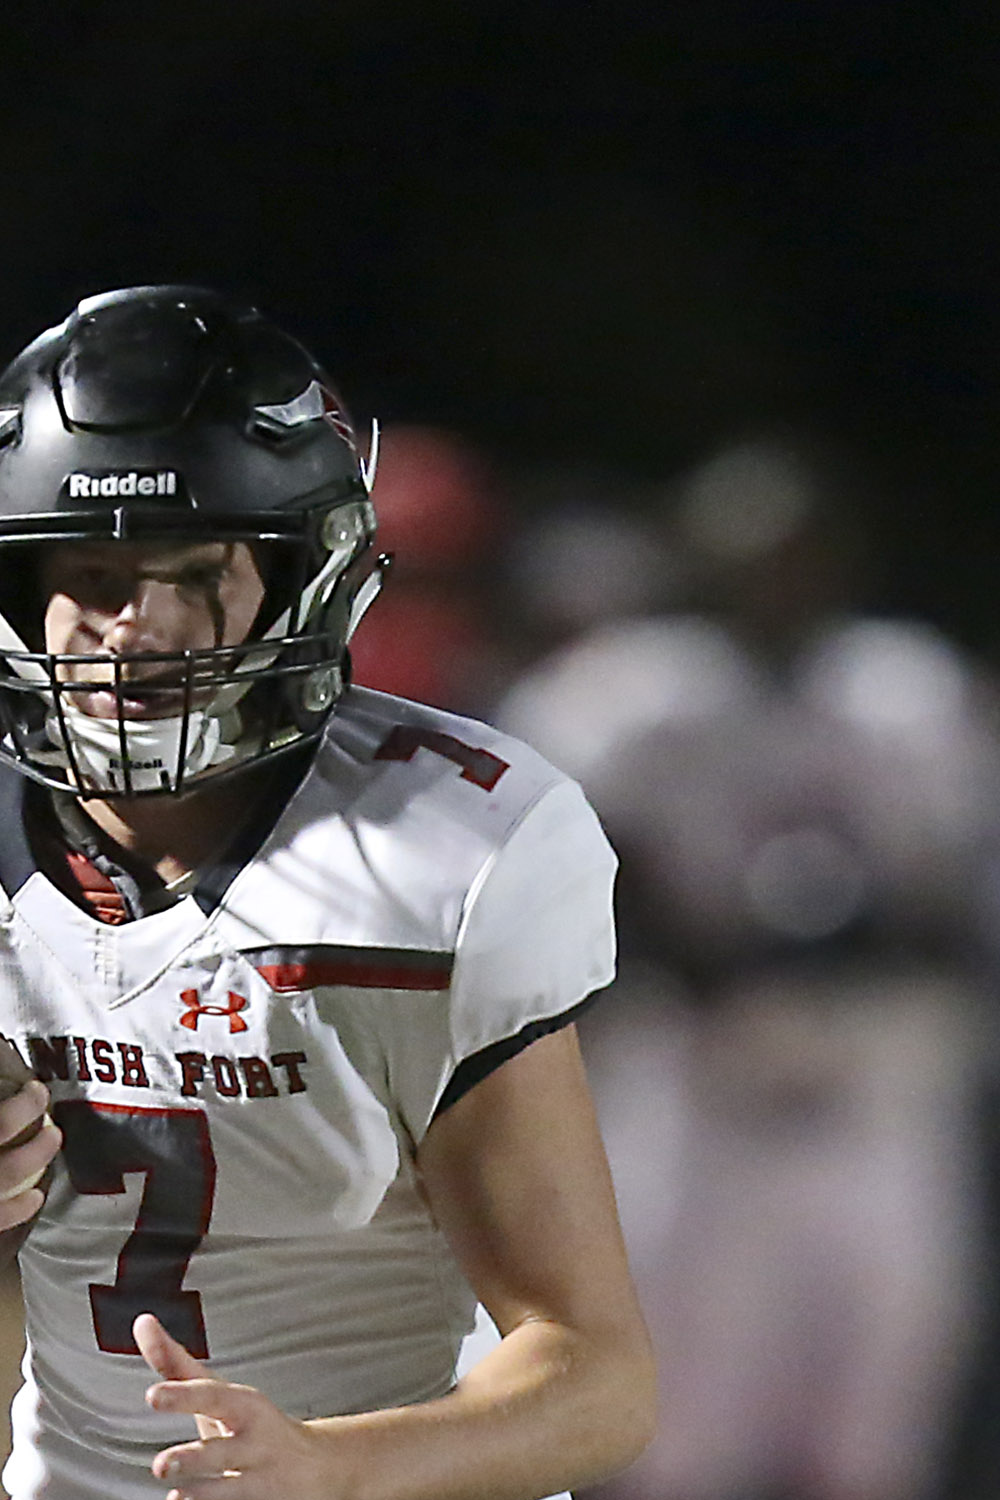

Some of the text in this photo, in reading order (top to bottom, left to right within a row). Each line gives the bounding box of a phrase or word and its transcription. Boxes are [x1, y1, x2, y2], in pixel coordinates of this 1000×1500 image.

[69, 472, 176, 497] Riddell
[109, 758, 163, 769] Rdell
[373, 725, 511, 793] 7
[28, 1035, 307, 1097] NISH FORT
[53, 1099, 218, 1359] 7
